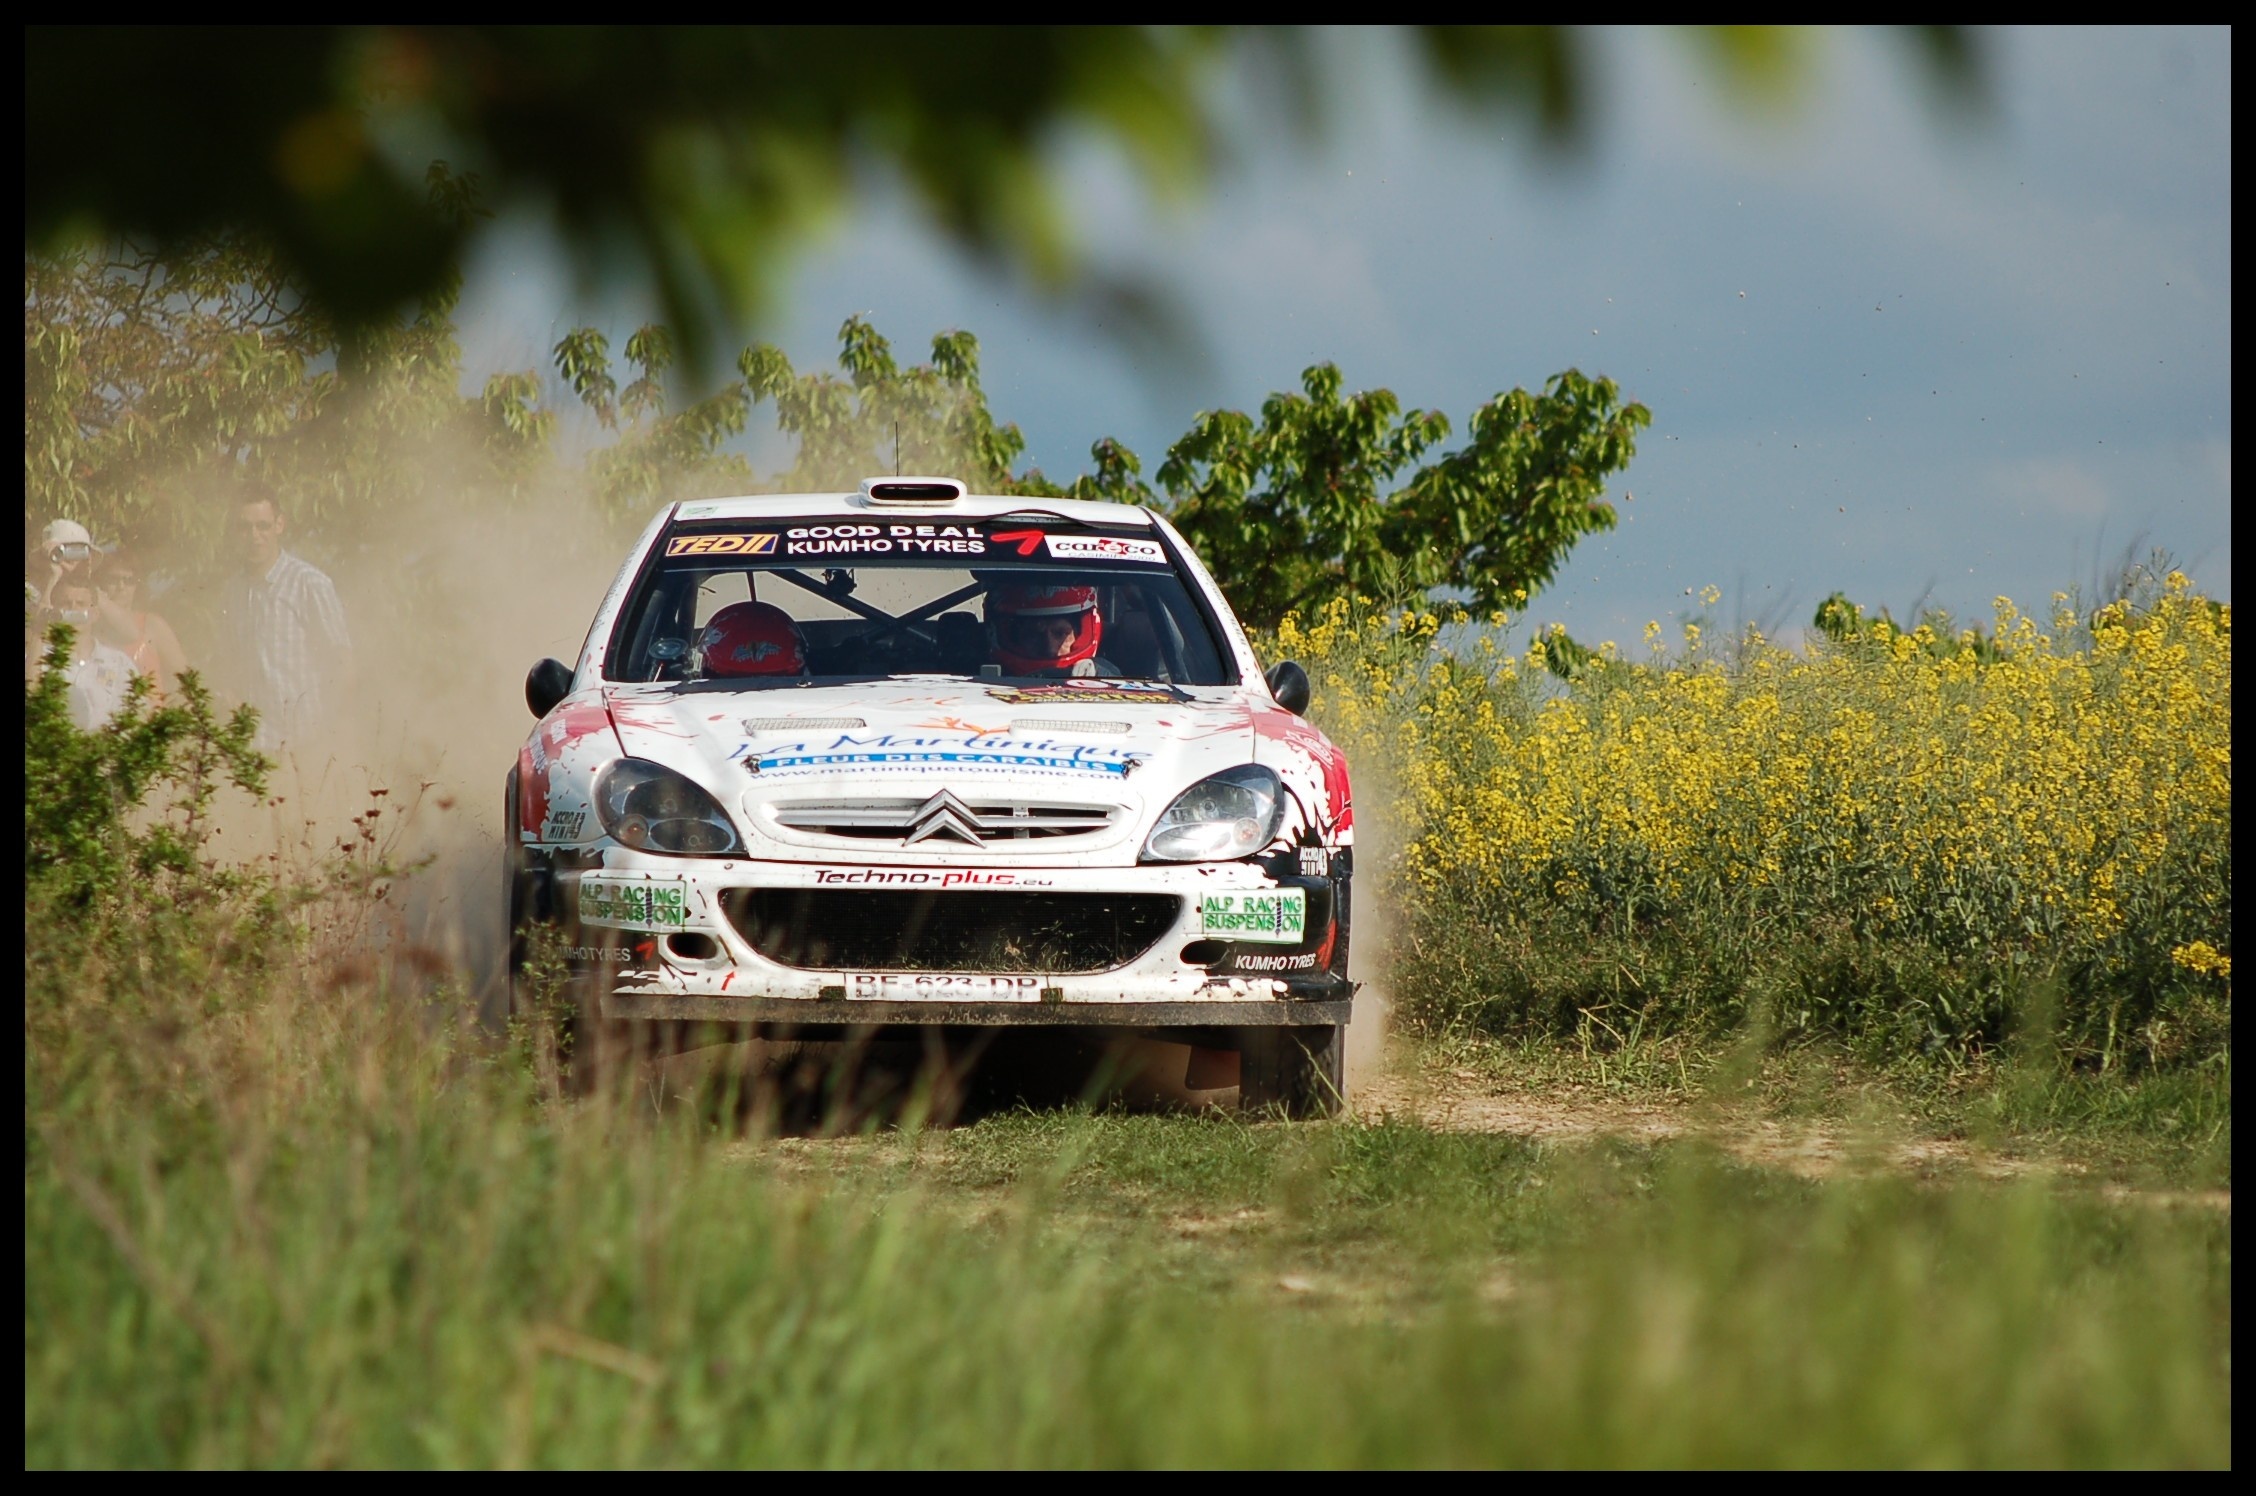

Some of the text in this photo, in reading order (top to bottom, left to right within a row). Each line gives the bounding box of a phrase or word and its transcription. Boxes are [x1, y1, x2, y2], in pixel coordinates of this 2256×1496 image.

[787, 526, 984, 539] GOOD DEAL
[787, 539, 986, 554] KUMHO TYRES
[726, 735, 1153, 762] La Martinique
[777, 754, 870, 767] FLEUR
[885, 754, 943, 762] DES
[815, 869, 1053, 887] Techno-plus.eu
[580, 884, 603, 900] ALP
[1204, 896, 1234, 911] ALP
[589, 947, 631, 962] TYRES
[1235, 953, 1316, 971] KUMHO TYRES
